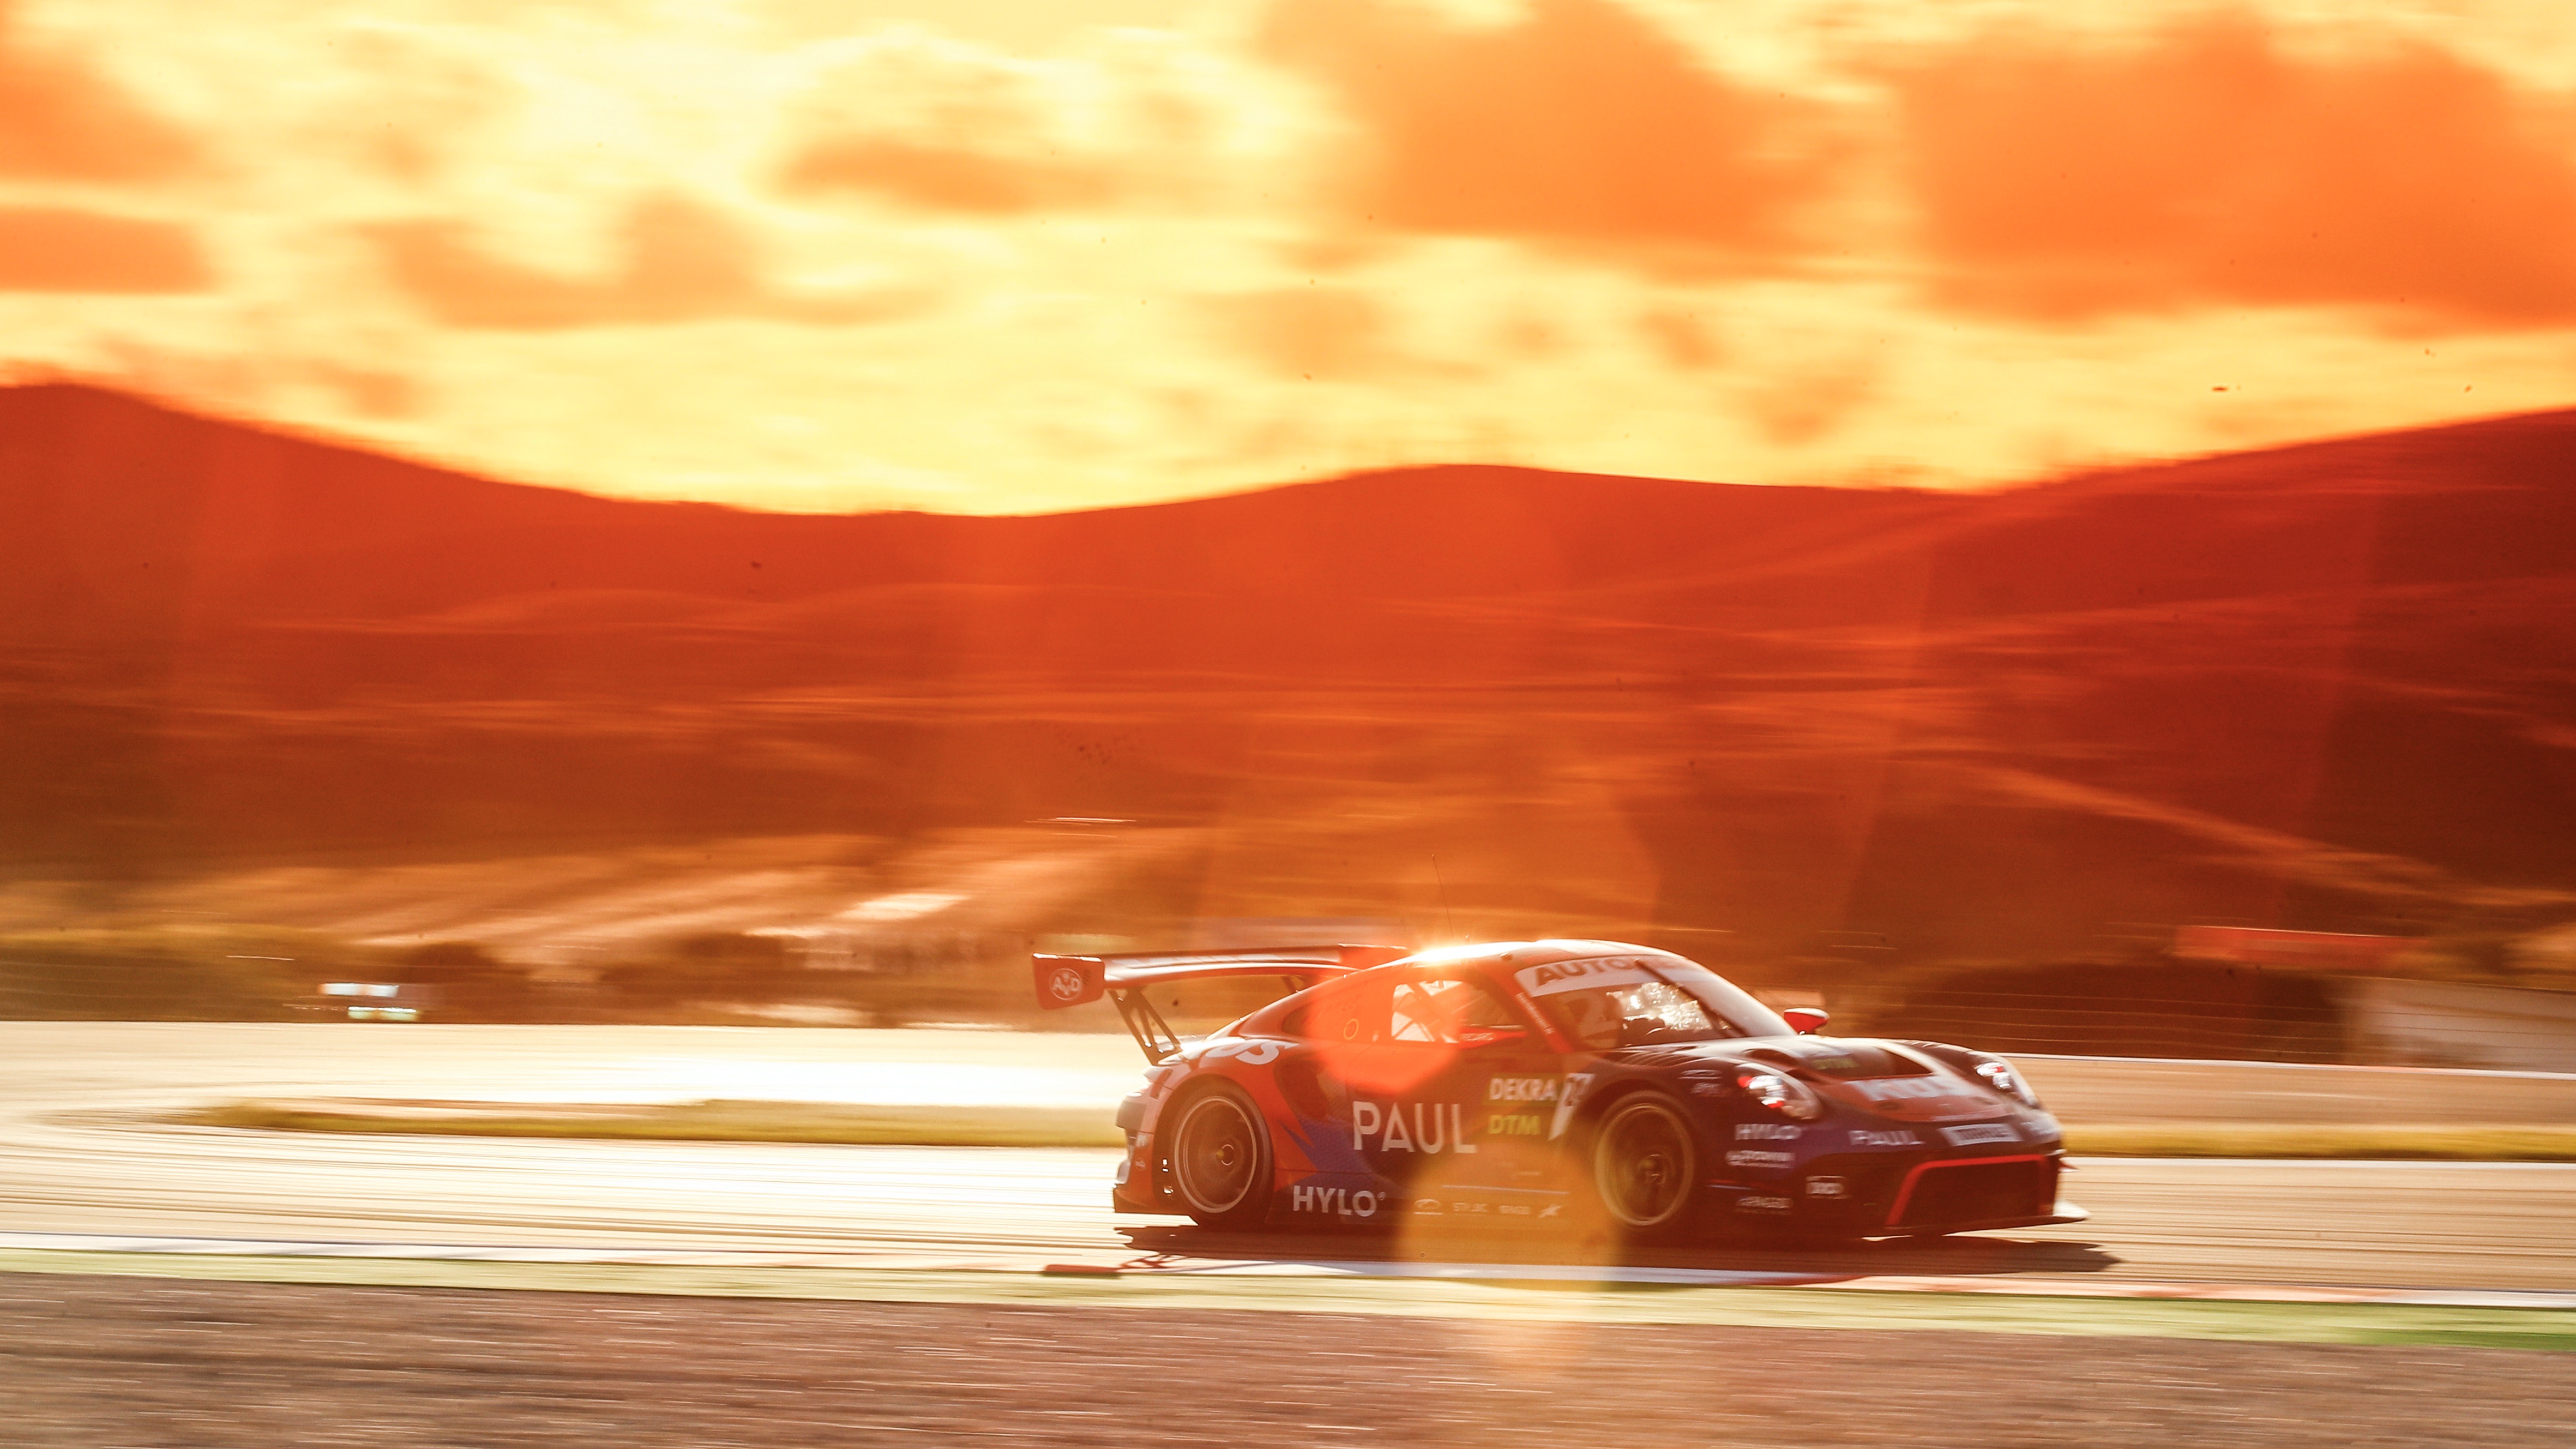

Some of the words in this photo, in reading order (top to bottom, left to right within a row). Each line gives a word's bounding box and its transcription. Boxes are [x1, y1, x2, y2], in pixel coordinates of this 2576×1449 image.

[1489, 1078, 1558, 1101] DEKRA
[1353, 1101, 1478, 1154] PAUL
[1488, 1115, 1541, 1135] DTM
